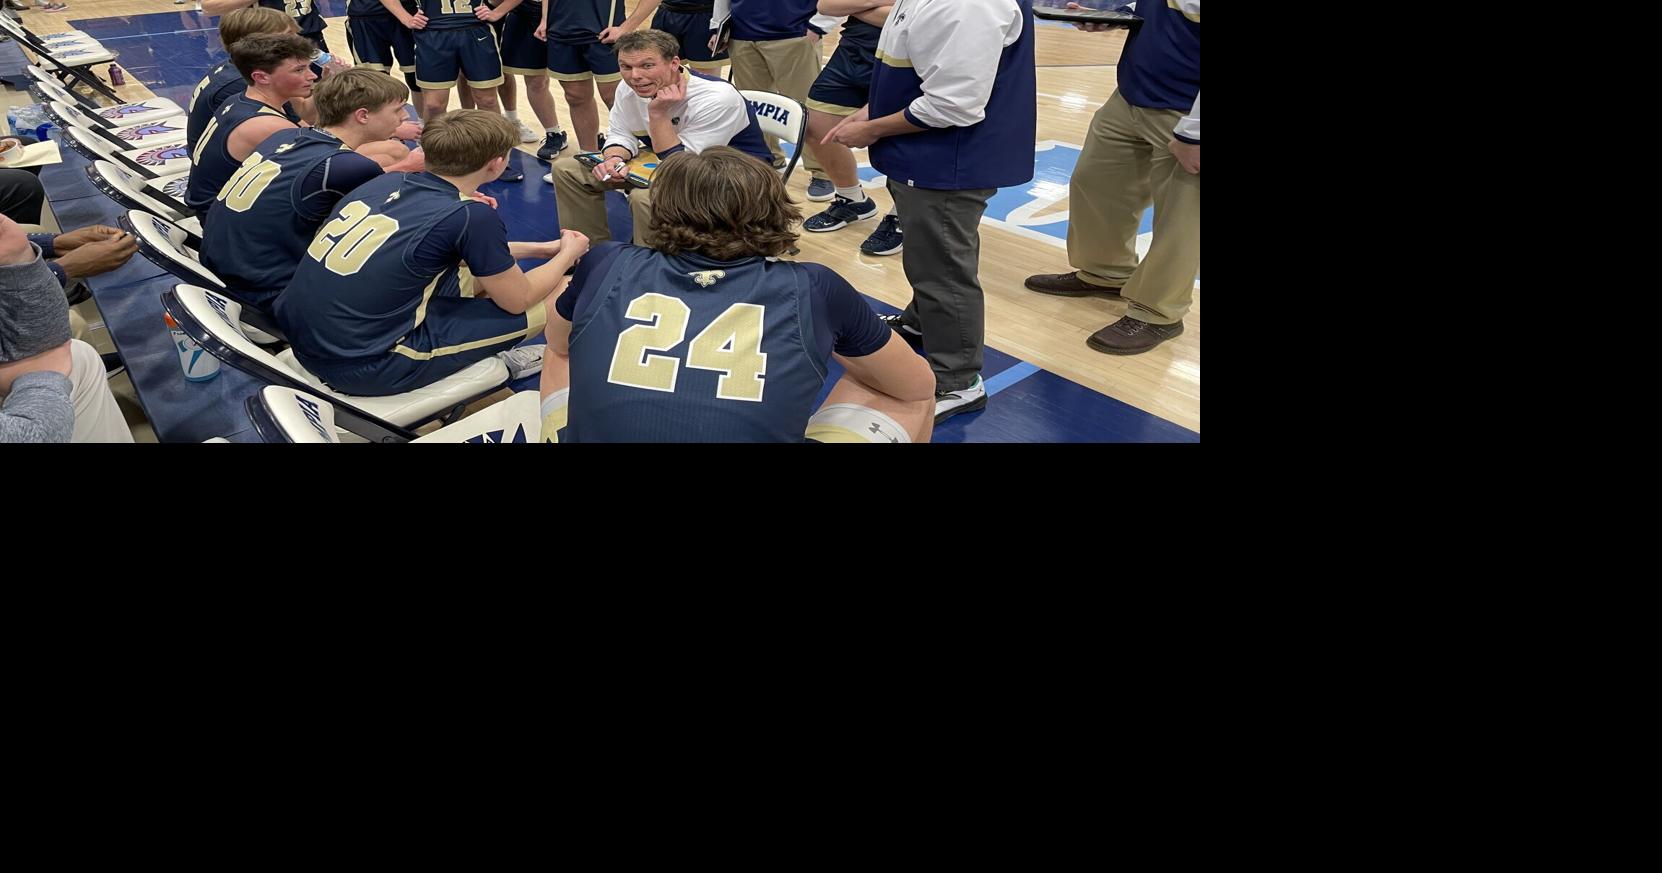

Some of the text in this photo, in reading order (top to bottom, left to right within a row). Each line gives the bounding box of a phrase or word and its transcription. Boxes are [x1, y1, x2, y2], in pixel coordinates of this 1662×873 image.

[441, 0, 473, 14] 12
[307, 200, 399, 276] 20
[606, 292, 768, 402] 24
